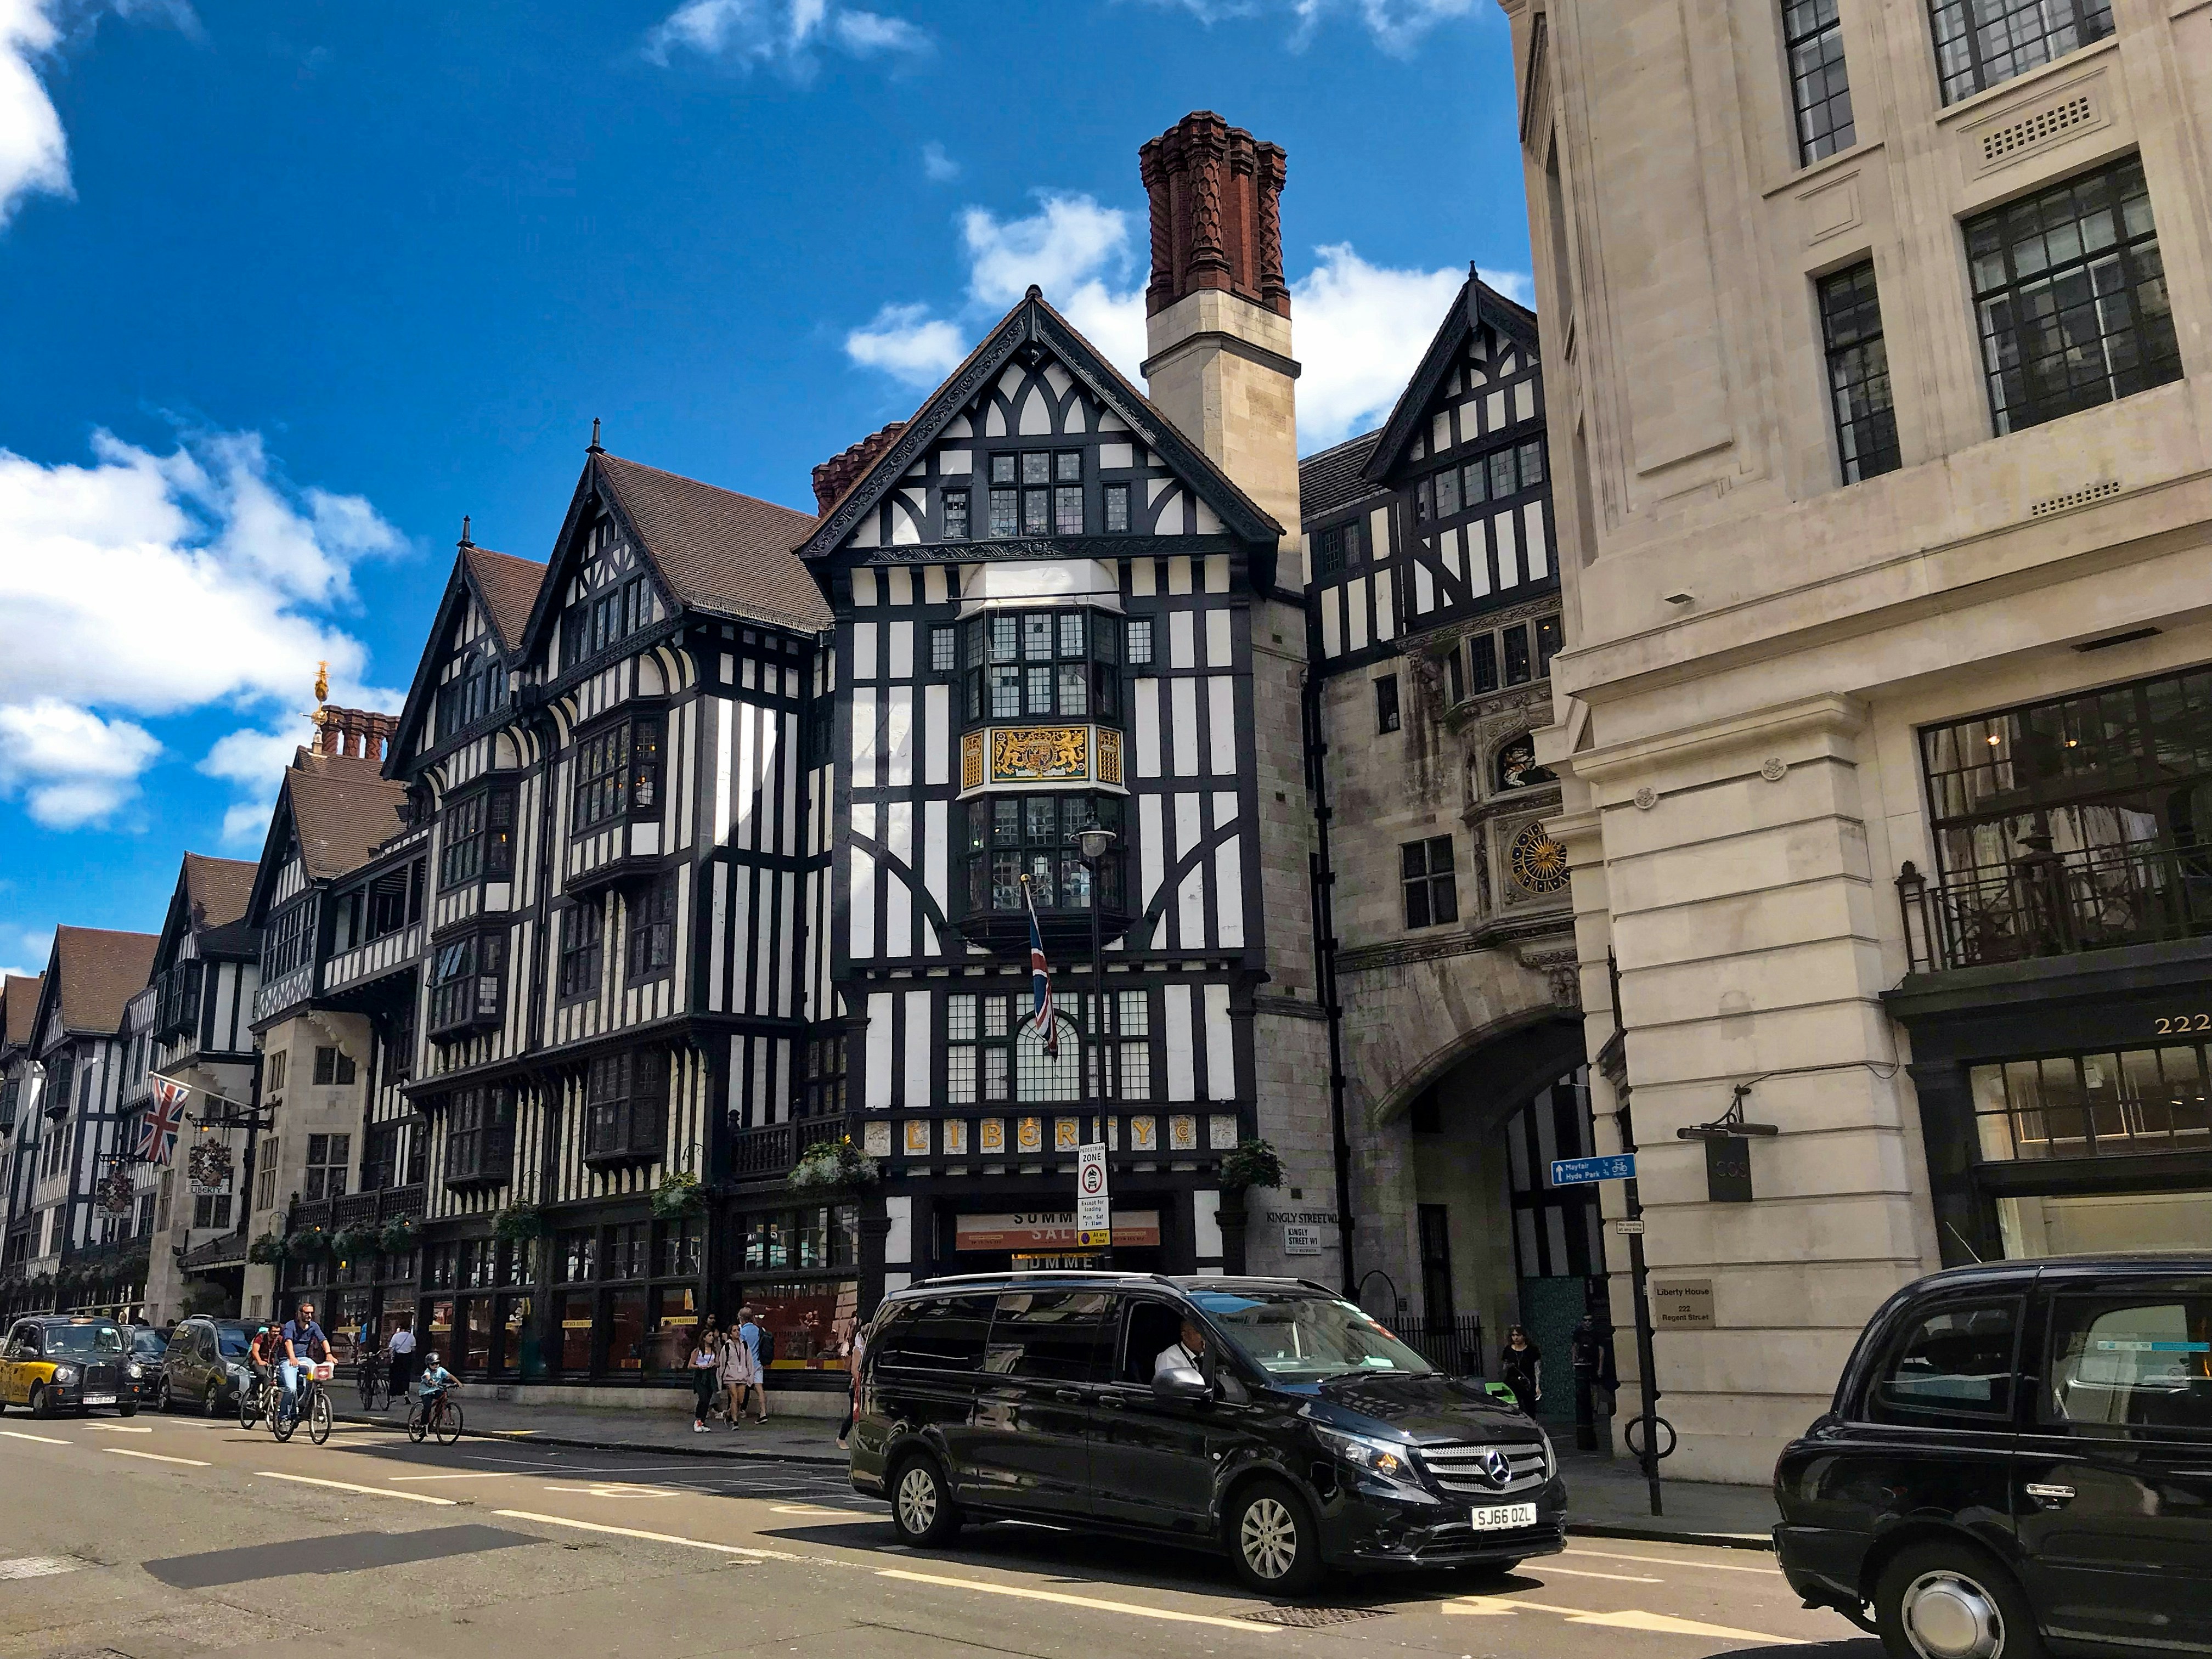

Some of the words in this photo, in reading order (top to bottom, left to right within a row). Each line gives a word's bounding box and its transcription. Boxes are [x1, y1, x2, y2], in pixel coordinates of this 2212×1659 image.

[2155, 1014, 2211, 1034] 222
[1080, 1145, 1104, 1153] PEDESTRIAN
[1083, 1153, 1101, 1162] ZONE
[1566, 1163, 1589, 1171] Mayfair
[1267, 1212, 1297, 1223] KINGLY
[1299, 1213, 1327, 1223] STREET
[1032, 1228, 1077, 1240] SAL
[544, 1477, 849, 1498] LEAR
[1478, 1509, 1508, 1526] SJ66
[1511, 1506, 1531, 1523] OZL
